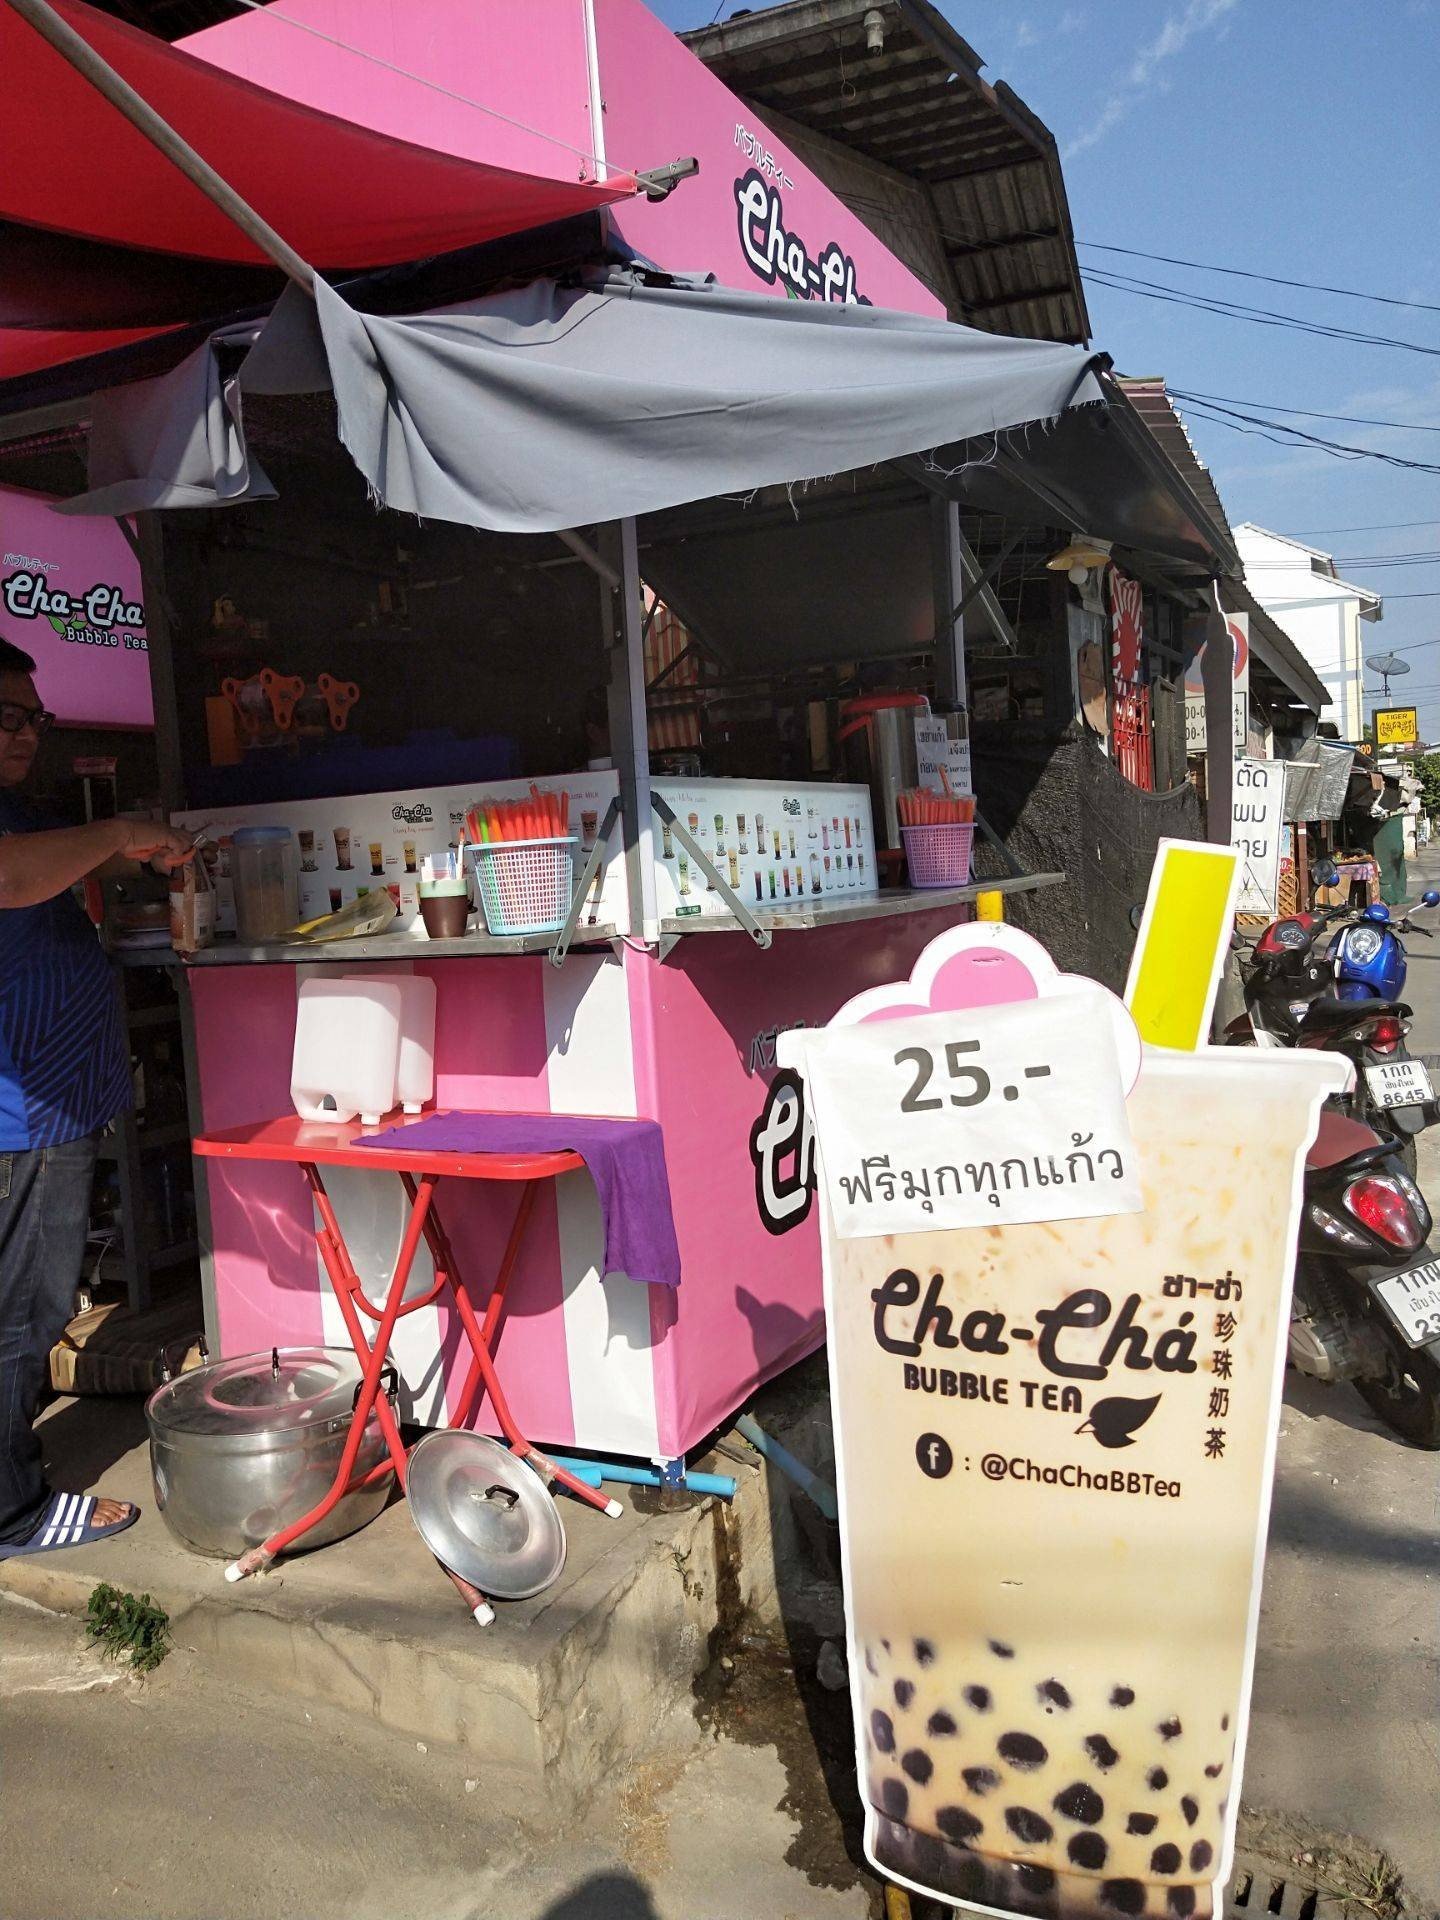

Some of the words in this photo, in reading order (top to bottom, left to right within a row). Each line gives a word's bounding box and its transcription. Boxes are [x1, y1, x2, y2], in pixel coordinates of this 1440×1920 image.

[734, 168, 872, 305] Cha-Ch
[3, 571, 145, 628] Cha-Cha
[67, 626, 118, 646] Bubble
[124, 634, 149, 650] Tea
[1237, 763, 1268, 788] ตัด
[1233, 804, 1267, 823] ผม
[893, 1039, 1051, 1113] 25.-
[1383, 1089, 1425, 1106] 8645
[839, 1131, 1124, 1213] ฟรีมุกทุกแก้ว
[903, 1363, 1008, 1405] BUBBLE
[1020, 1381, 1083, 1414] TEA
[1204, 1311, 1238, 1459] 珍珠奶茶
[981, 1453, 1181, 1498] @ChaChaBBTea
